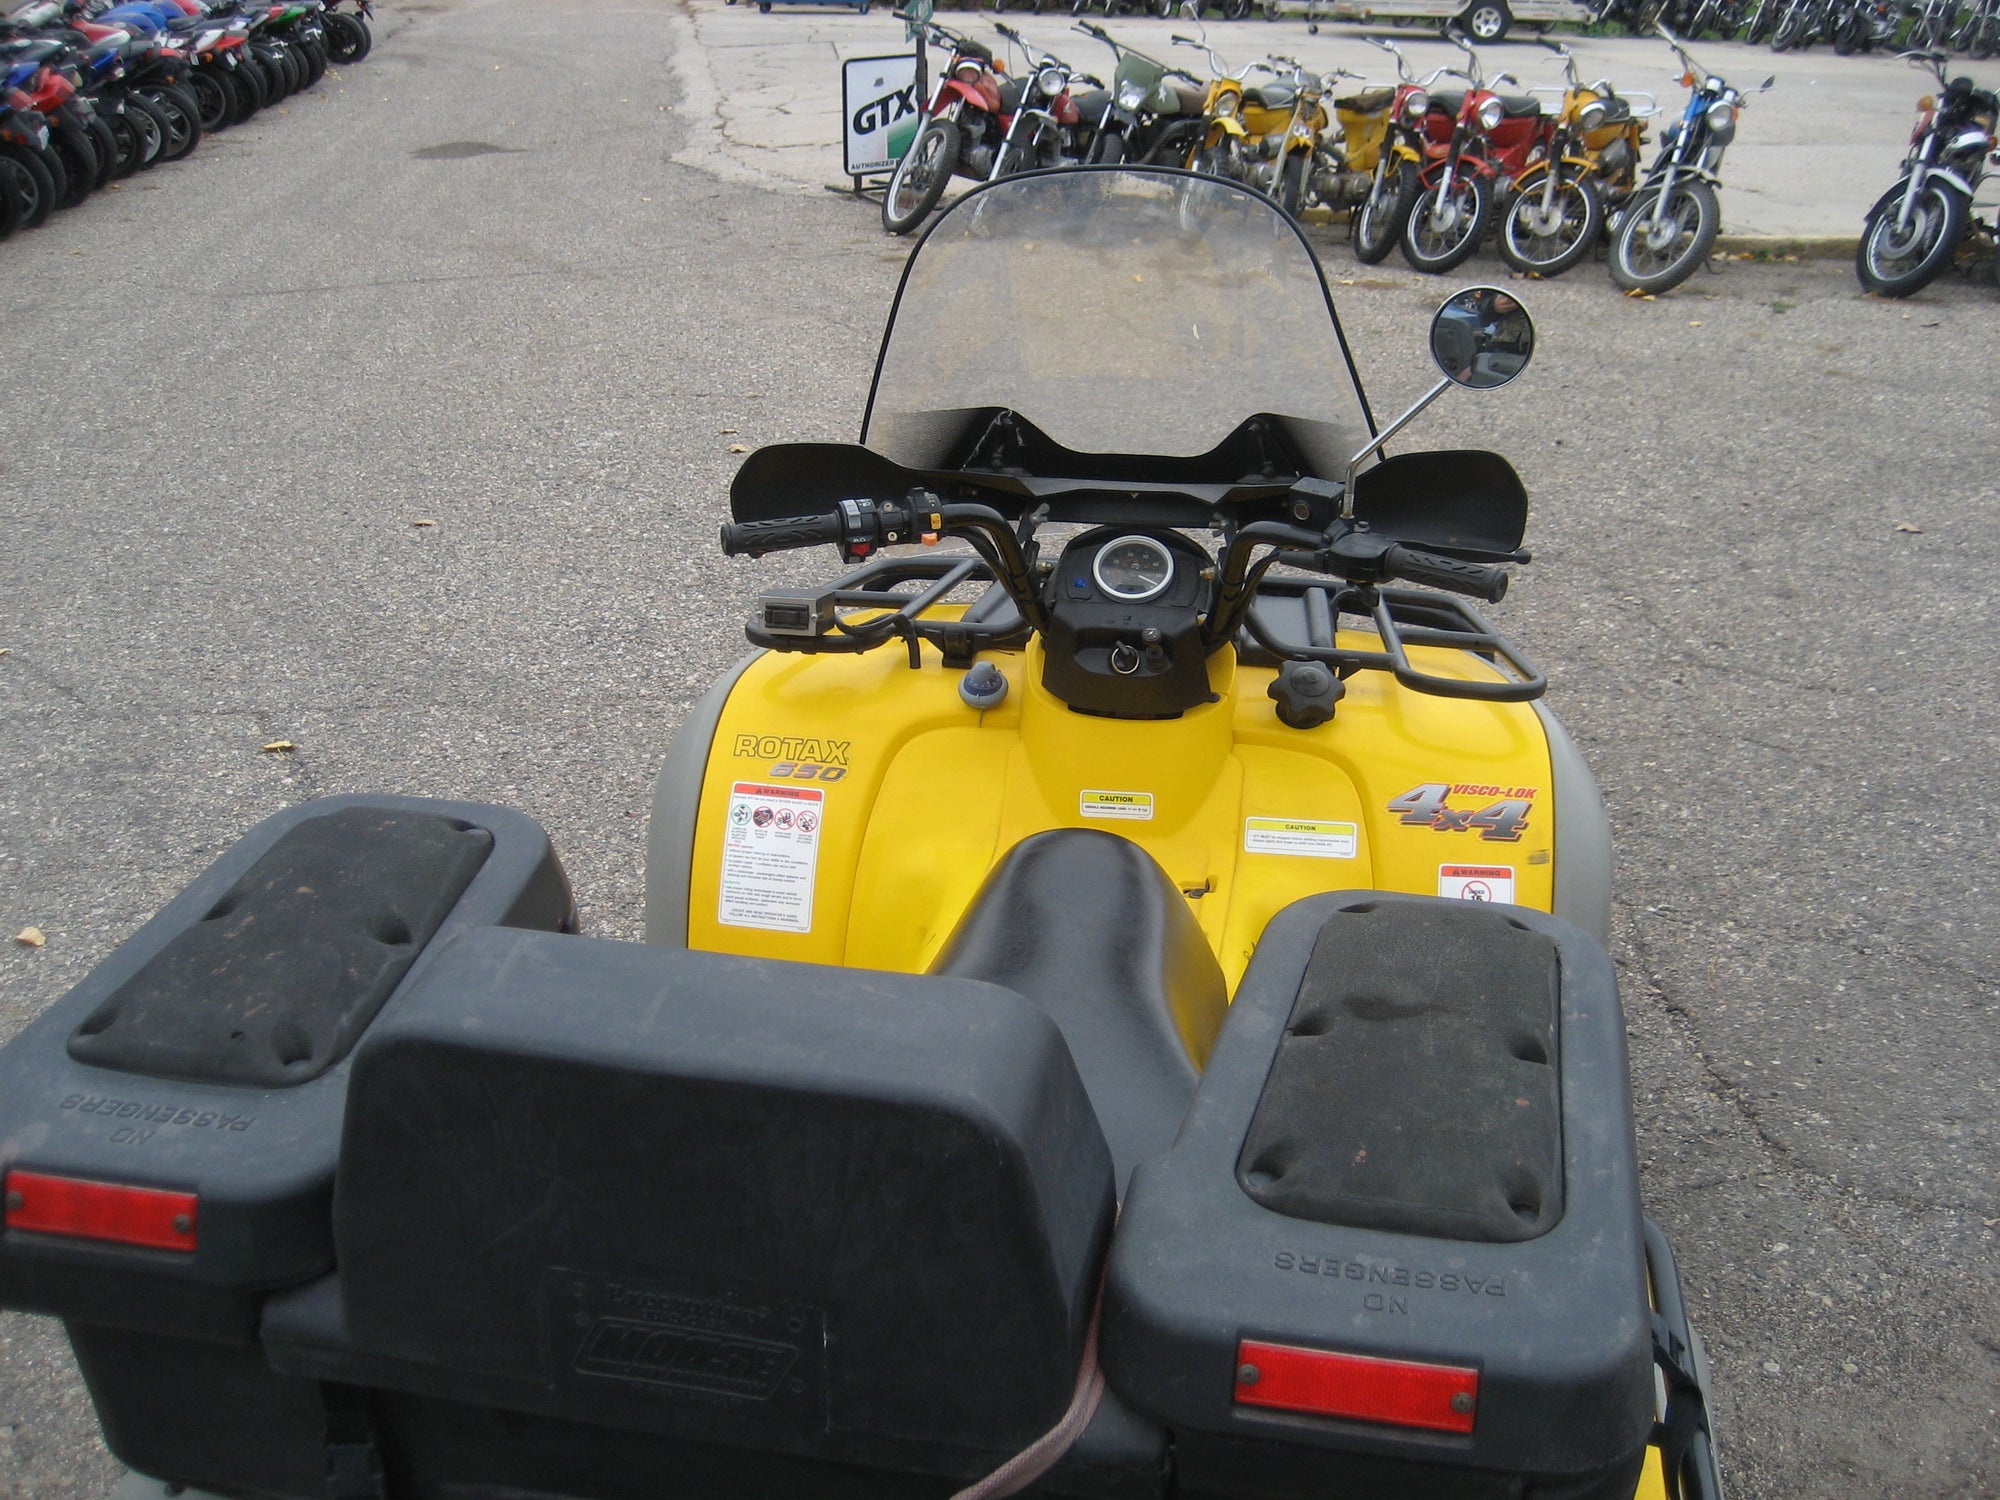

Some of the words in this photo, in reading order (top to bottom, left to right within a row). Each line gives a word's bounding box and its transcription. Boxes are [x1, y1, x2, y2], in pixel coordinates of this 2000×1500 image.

[853, 84, 915, 135] GTX
[851, 160, 895, 170] AUTHORIZED
[733, 734, 851, 765] ROTAX
[769, 762, 847, 782] 650
[763, 788, 800, 797] WARNING
[1099, 795, 1134, 803] CAUTION
[1452, 784, 1538, 799] VISCO-LOK
[1387, 782, 1532, 842] 4x4
[1285, 824, 1317, 832] CAUTION
[1460, 869, 1501, 877] WARNING
[60, 1094, 256, 1132] PASSENGERS
[109, 1128, 157, 1145] NO
[1274, 1251, 1506, 1297] PASSENGERS
[1363, 1293, 1408, 1315] NO
